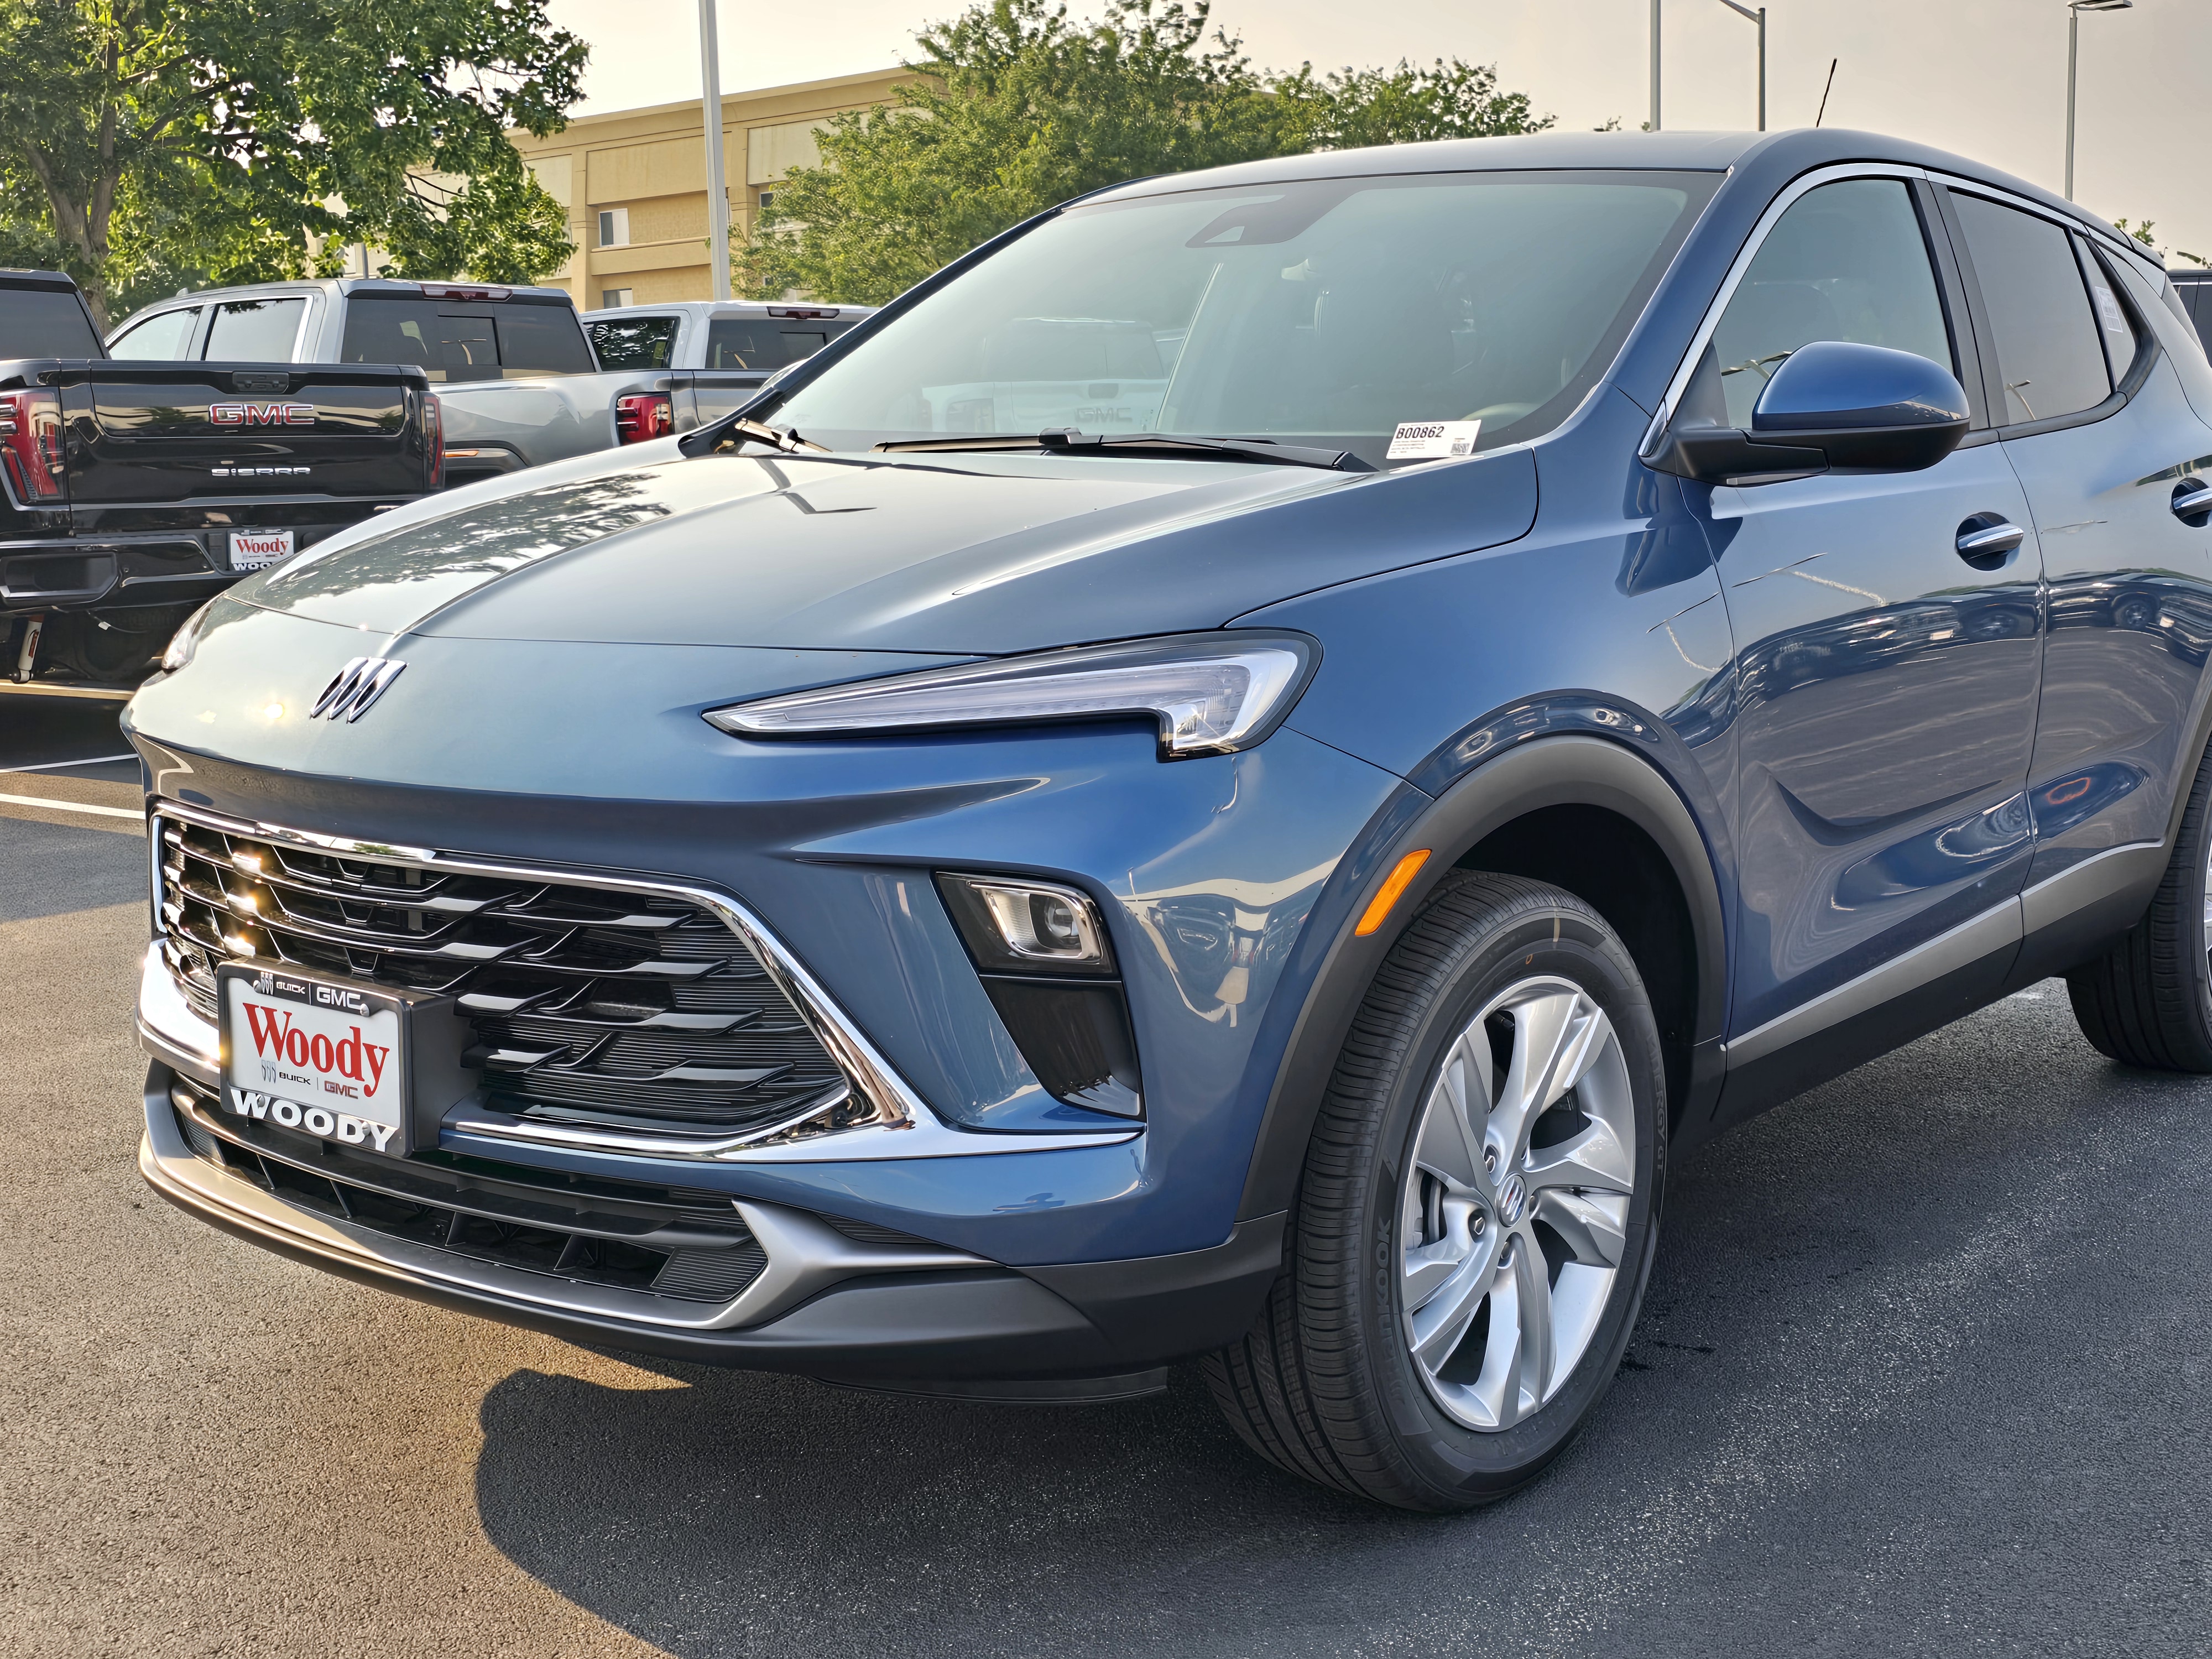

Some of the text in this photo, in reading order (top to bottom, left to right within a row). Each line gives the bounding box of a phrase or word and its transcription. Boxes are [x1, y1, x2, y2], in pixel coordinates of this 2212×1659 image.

[209, 404, 315, 425] GMC
[1074, 408, 1133, 423] GMC
[1396, 426, 1444, 439] B00862
[211, 467, 311, 476] SIERRA
[236, 538, 289, 555] Woody
[233, 562, 272, 571] WOO
[276, 982, 361, 1009] BUICK GMC
[243, 1003, 389, 1098] Woody
[279, 1072, 358, 1099] BUICK GMC
[230, 1089, 395, 1152] WOODY
